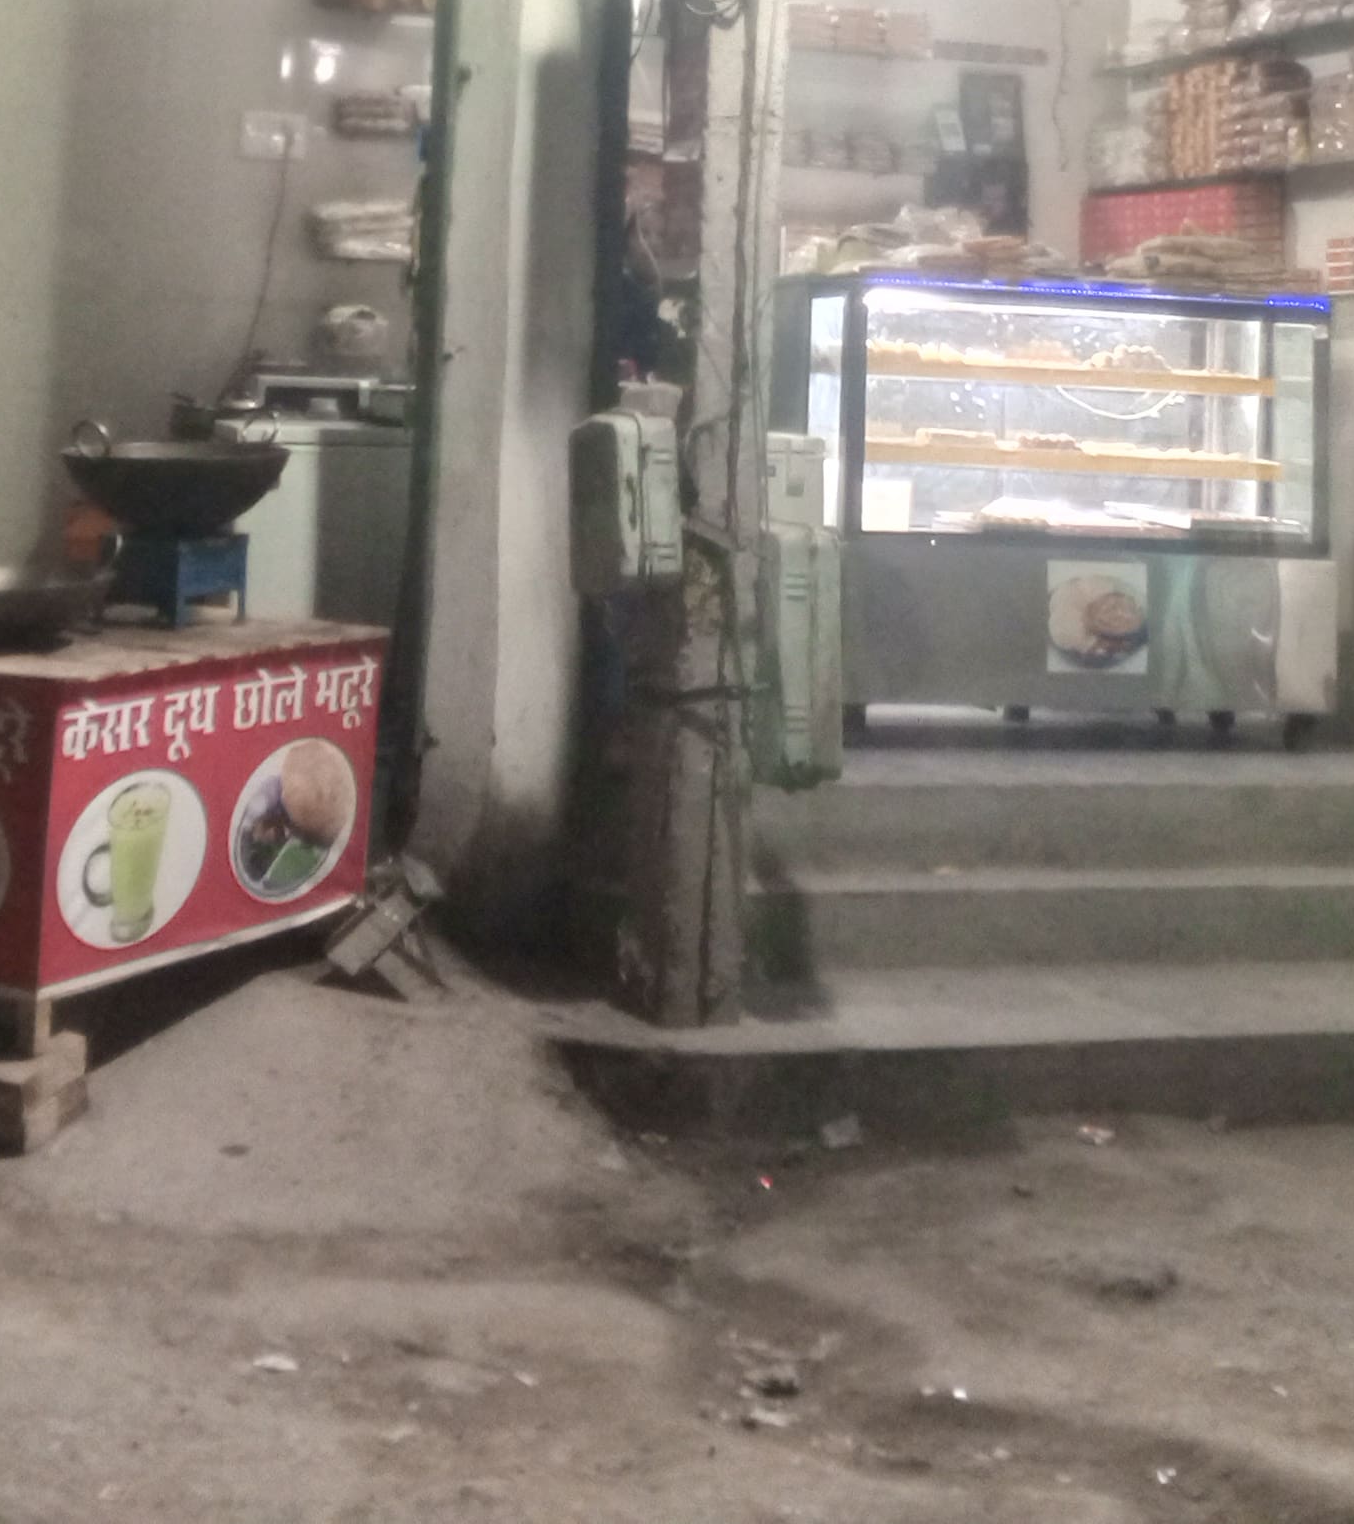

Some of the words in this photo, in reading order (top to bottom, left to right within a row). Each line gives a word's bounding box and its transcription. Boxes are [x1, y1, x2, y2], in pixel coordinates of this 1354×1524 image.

[61, 694, 155, 761] केसर
[162, 683, 221, 764] दूध
[231, 665, 308, 732] छोले
[314, 653, 379, 731] भटूरे
